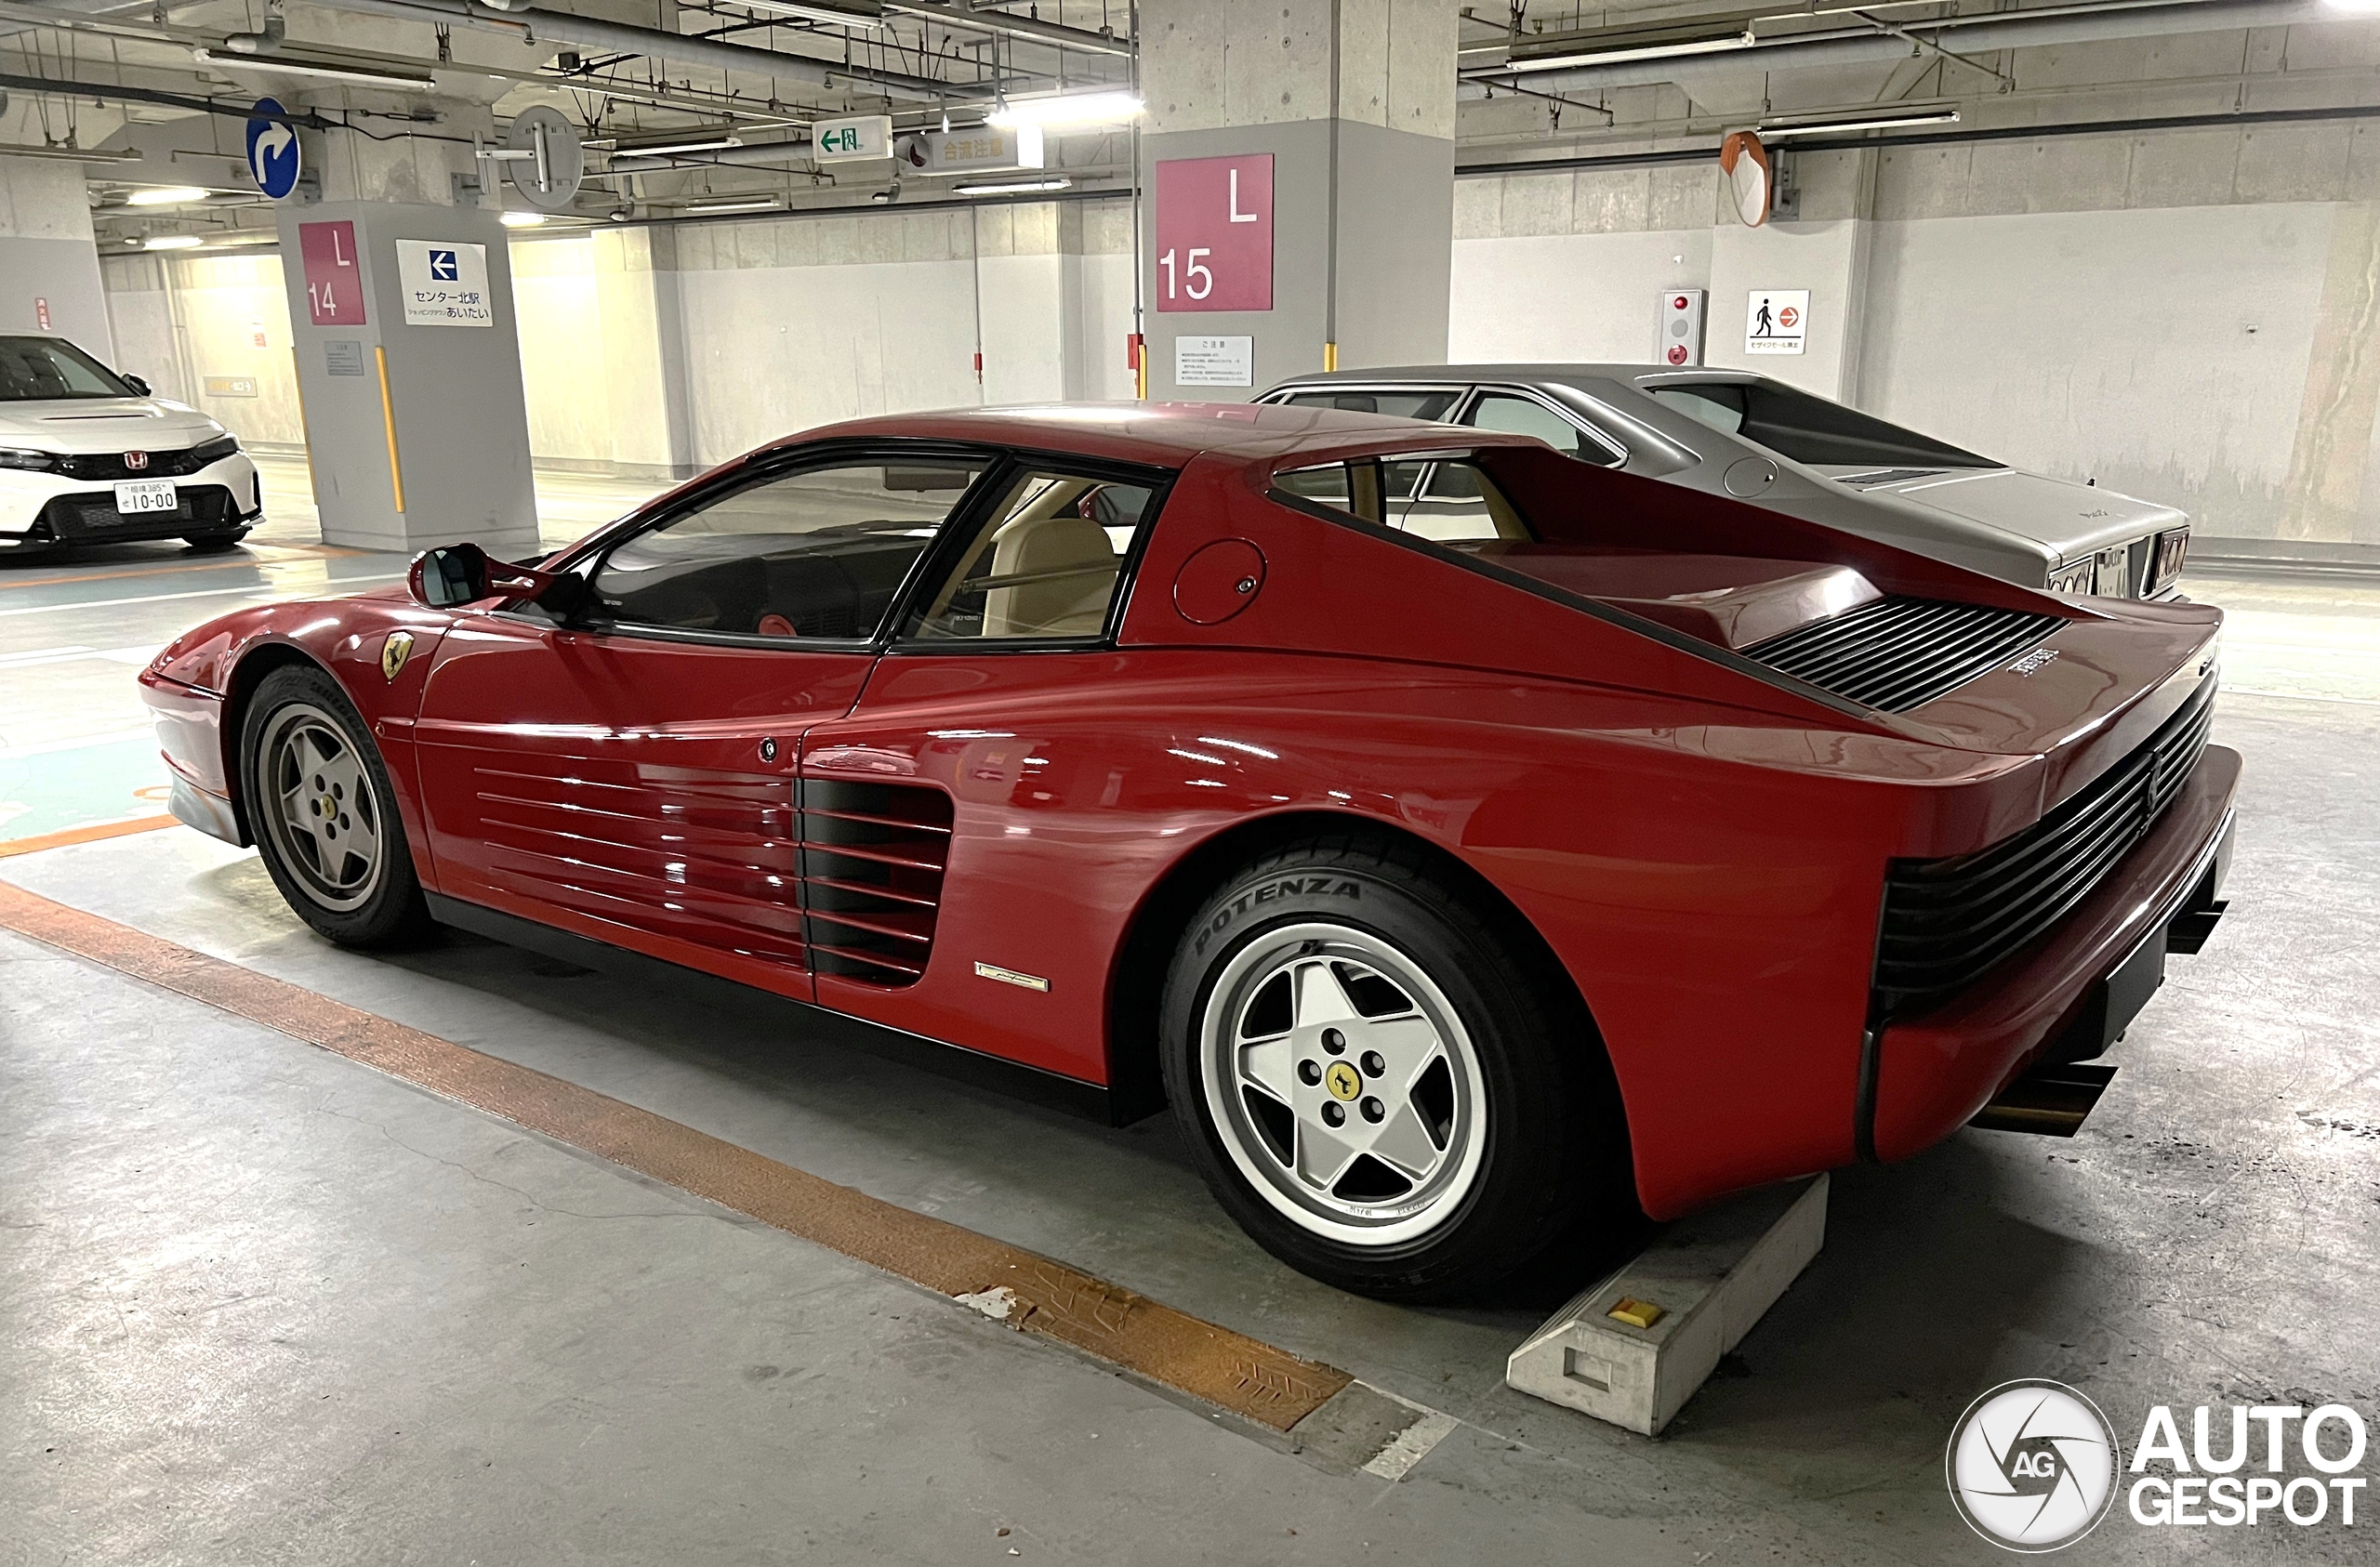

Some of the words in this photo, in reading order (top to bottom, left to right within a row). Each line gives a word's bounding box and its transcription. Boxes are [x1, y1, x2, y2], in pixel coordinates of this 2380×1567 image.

[943, 138, 1004, 161] 合流注意
[1229, 169, 1257, 223] L
[333, 230, 350, 267] L
[1159, 248, 1213, 300] 15
[309, 282, 337, 317] 14
[415, 290, 481, 305] センター北駅
[446, 308, 489, 319] あいたい
[133, 493, 174, 509] 10-00
[1193, 876, 1363, 956] POTENZA
